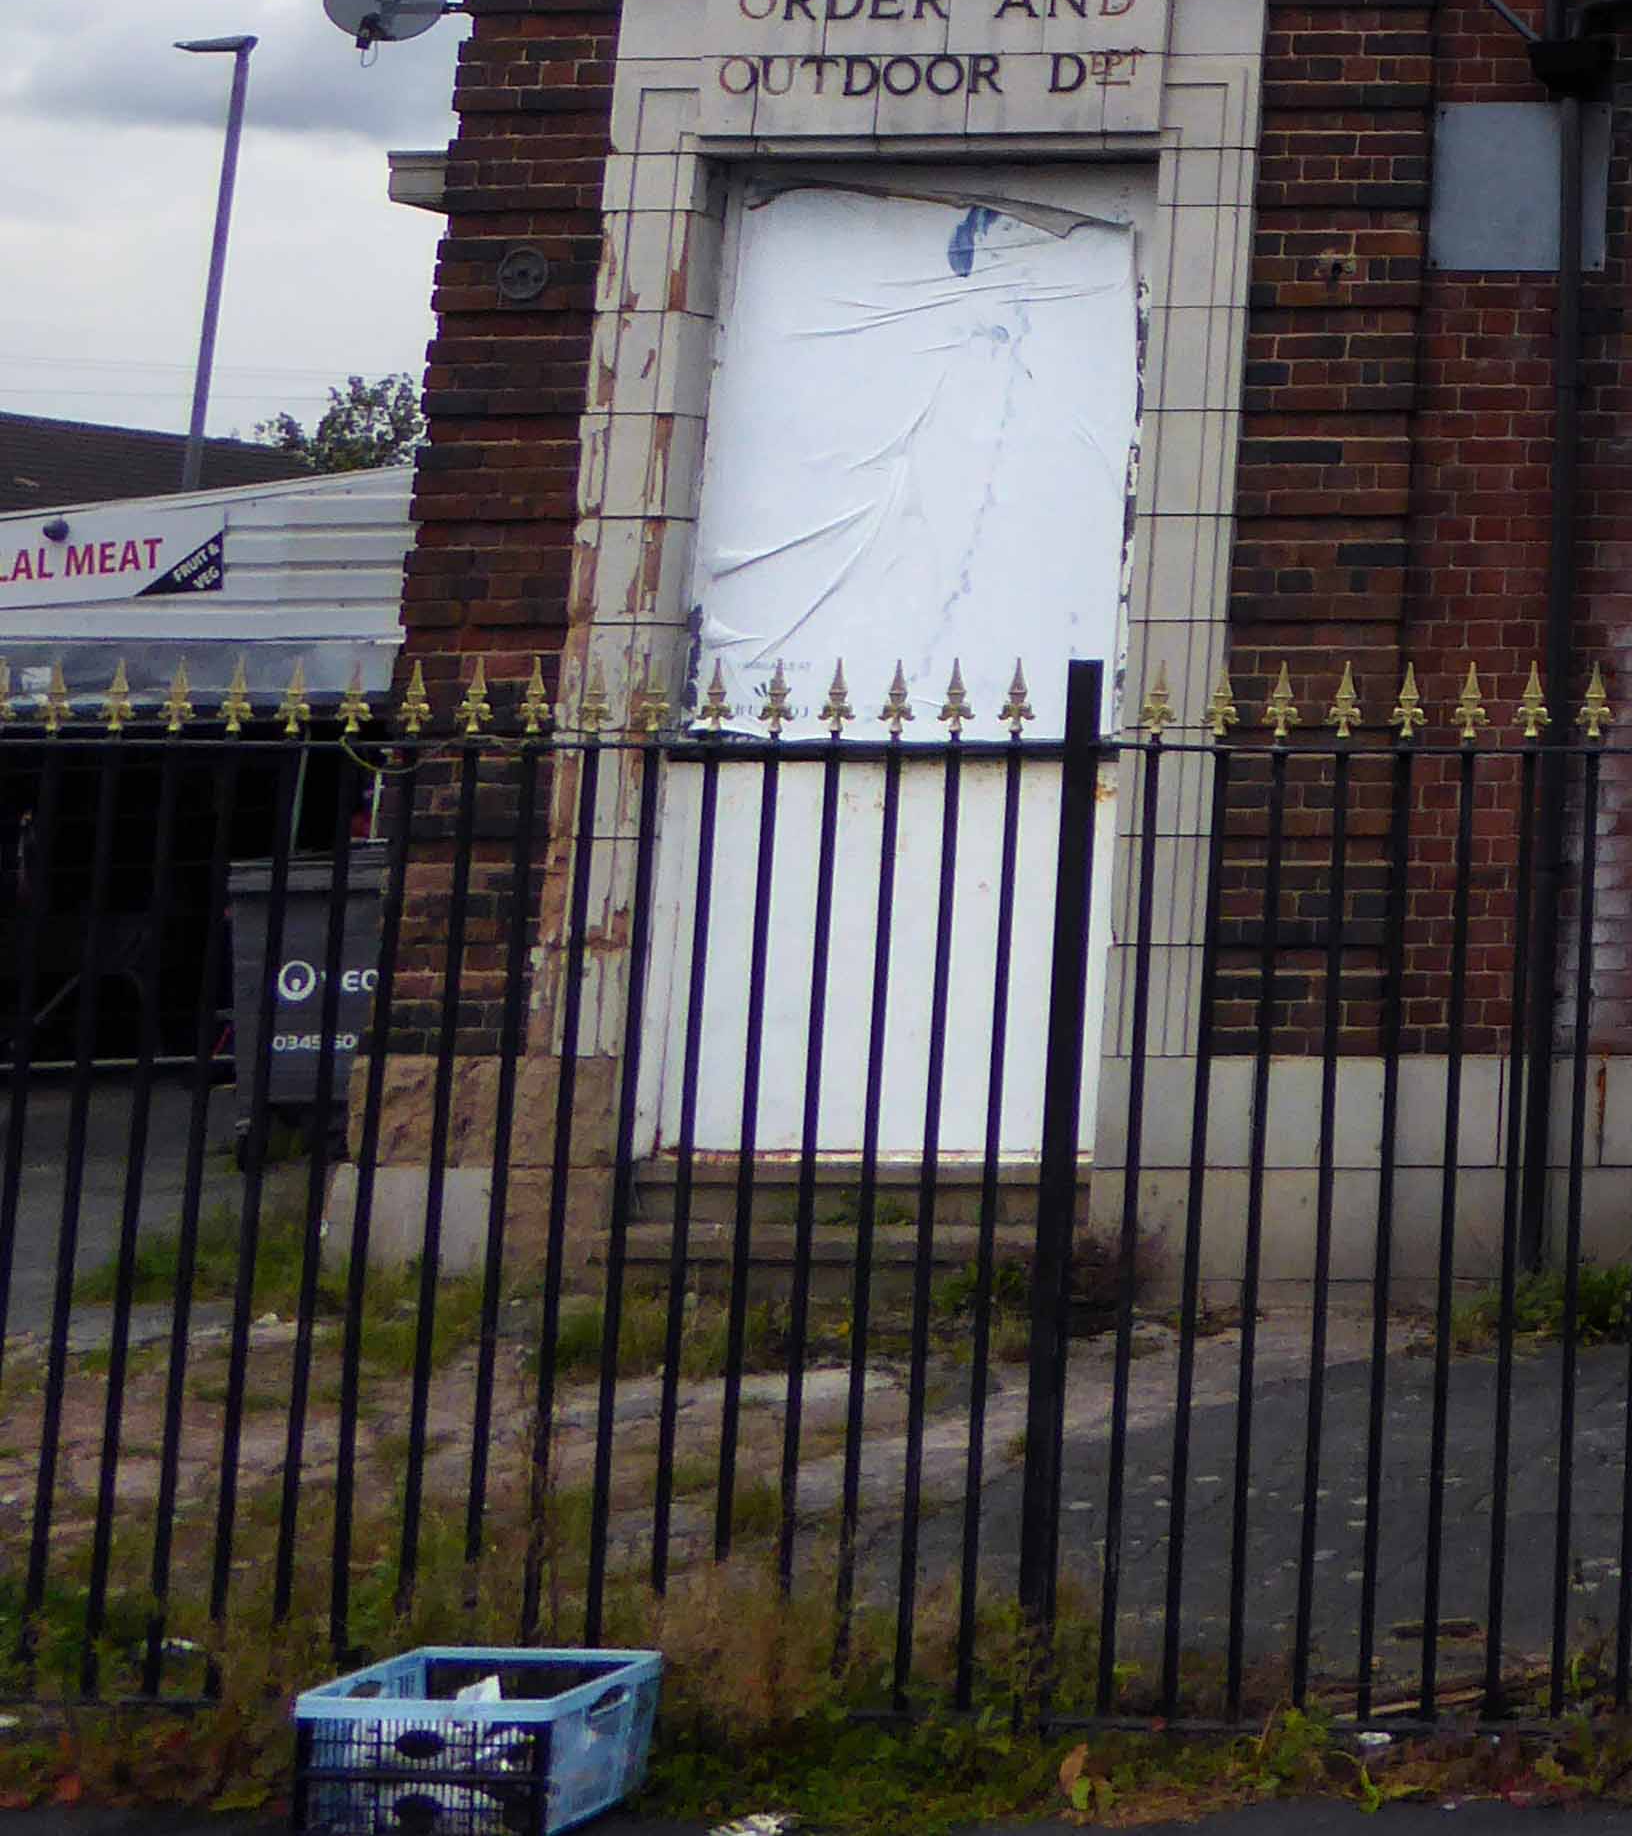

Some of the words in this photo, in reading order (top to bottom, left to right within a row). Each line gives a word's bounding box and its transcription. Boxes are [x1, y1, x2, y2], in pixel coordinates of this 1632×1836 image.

[719, 53, 1004, 97] OUTDOOR
[64, 537, 163, 578] MEAT
[173, 549, 208, 582] FRUIT
[192, 566, 220, 589] VEG
